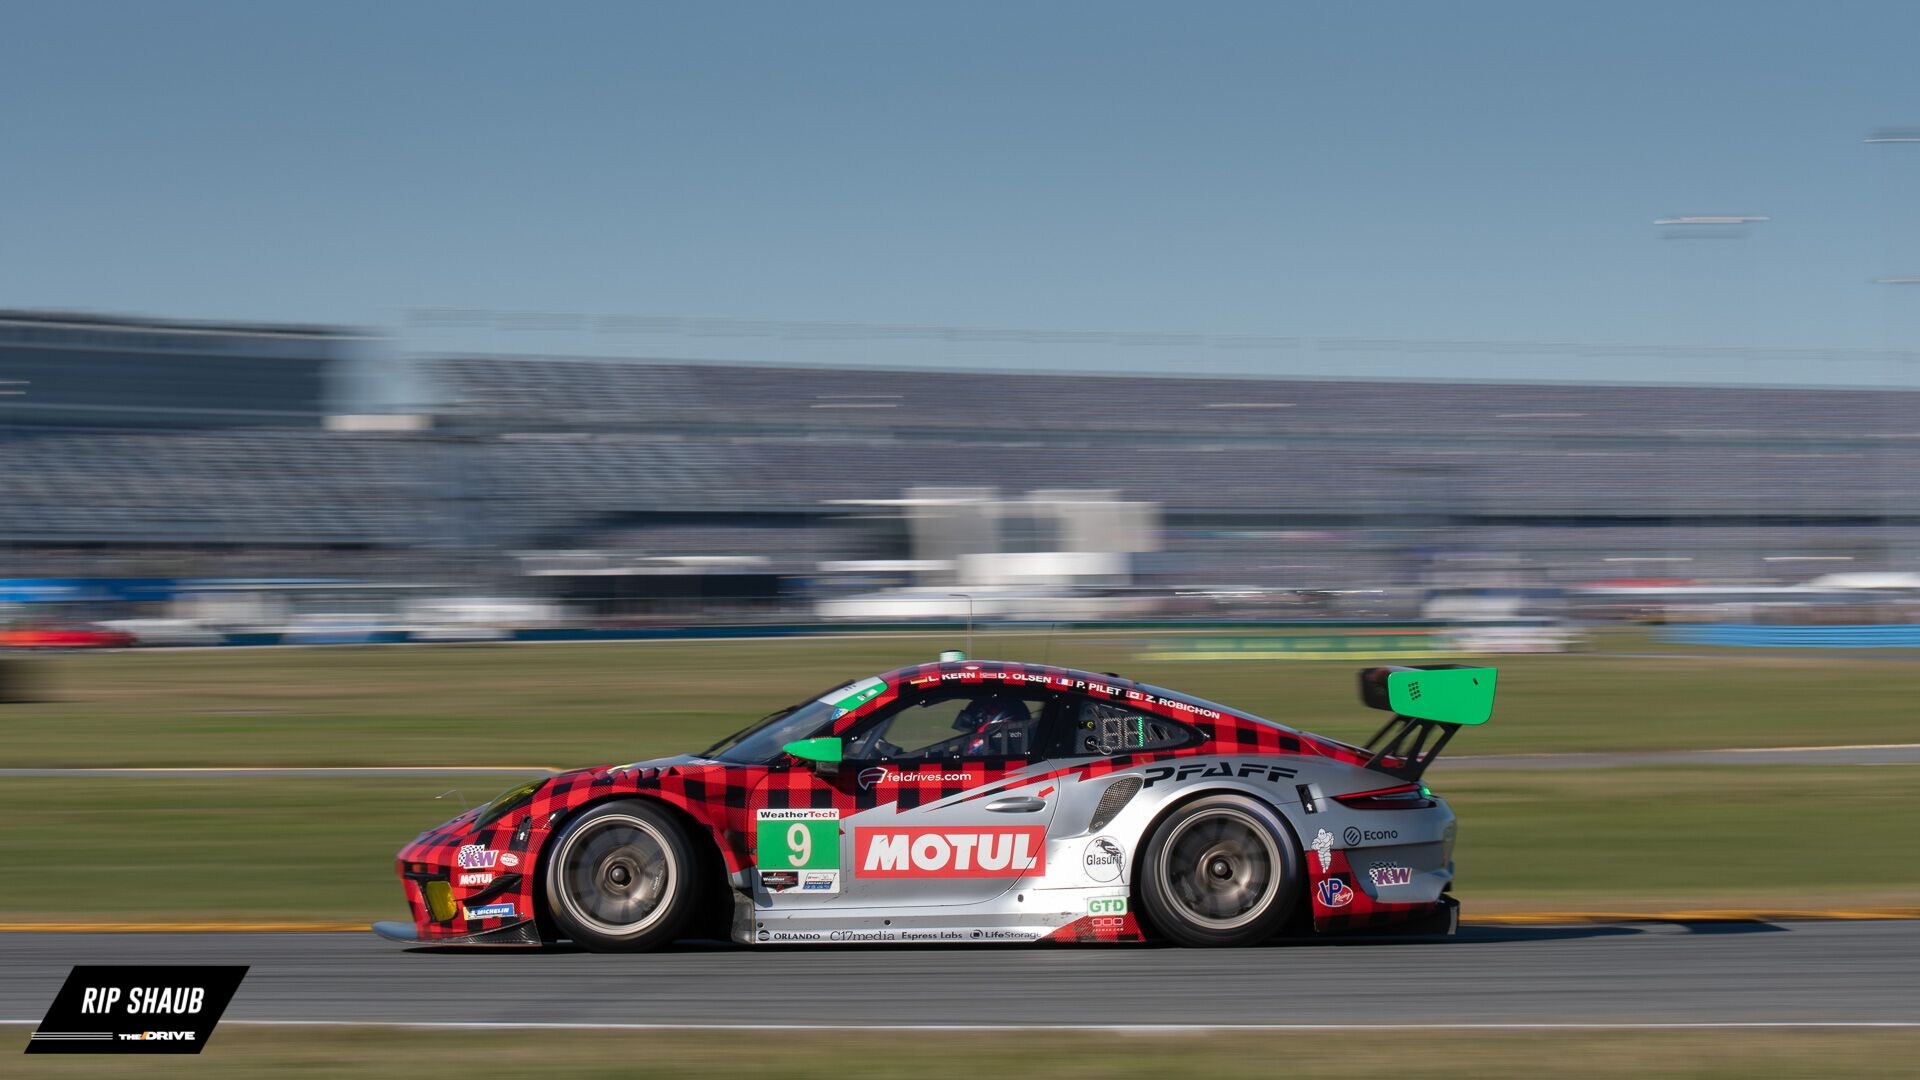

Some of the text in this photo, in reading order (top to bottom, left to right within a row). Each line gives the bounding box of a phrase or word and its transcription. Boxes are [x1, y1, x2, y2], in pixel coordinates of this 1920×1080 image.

[941, 672, 976, 680] KERN
[997, 672, 1052, 684] D. OLSEN
[1076, 680, 1122, 696] P. PILET
[1144, 694, 1221, 719] Z. ROBICHON
[886, 772, 972, 782] feldrives.com
[1142, 761, 1298, 789] PFAFF
[760, 811, 837, 819] WeatherTech
[1364, 829, 1398, 841] Econo
[787, 822, 812, 867] 9
[863, 833, 1038, 871] MOTUL
[465, 850, 496, 867] KW
[1086, 854, 1122, 866] Glasurit
[459, 873, 493, 885] MOTUL
[1377, 868, 1410, 885] KW
[1319, 879, 1342, 905] VP
[477, 907, 510, 915] MICHELIN
[1089, 899, 1124, 913] GTD
[829, 931, 895, 941] C17media
[901, 931, 963, 940] Espress Labs
